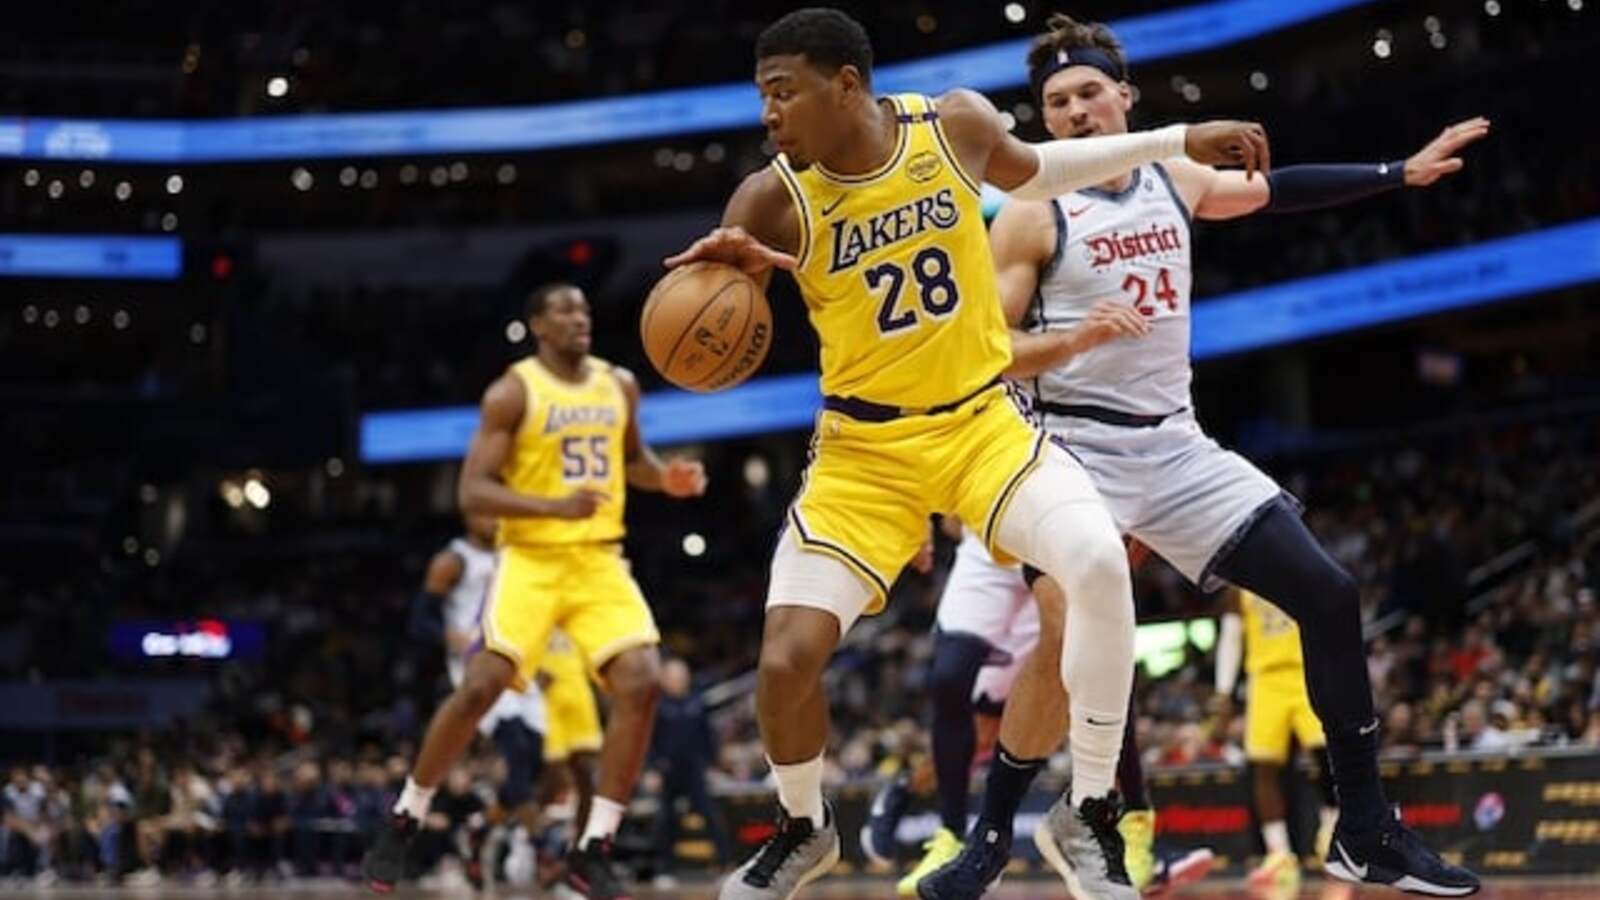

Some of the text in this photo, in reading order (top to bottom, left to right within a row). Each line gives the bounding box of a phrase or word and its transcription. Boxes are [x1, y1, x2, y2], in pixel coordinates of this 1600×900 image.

[828, 188, 959, 275] LAKERS
[1085, 222, 1181, 268] District
[863, 246, 960, 337] 28
[1121, 267, 1179, 317] 24
[561, 434, 610, 482] 55
